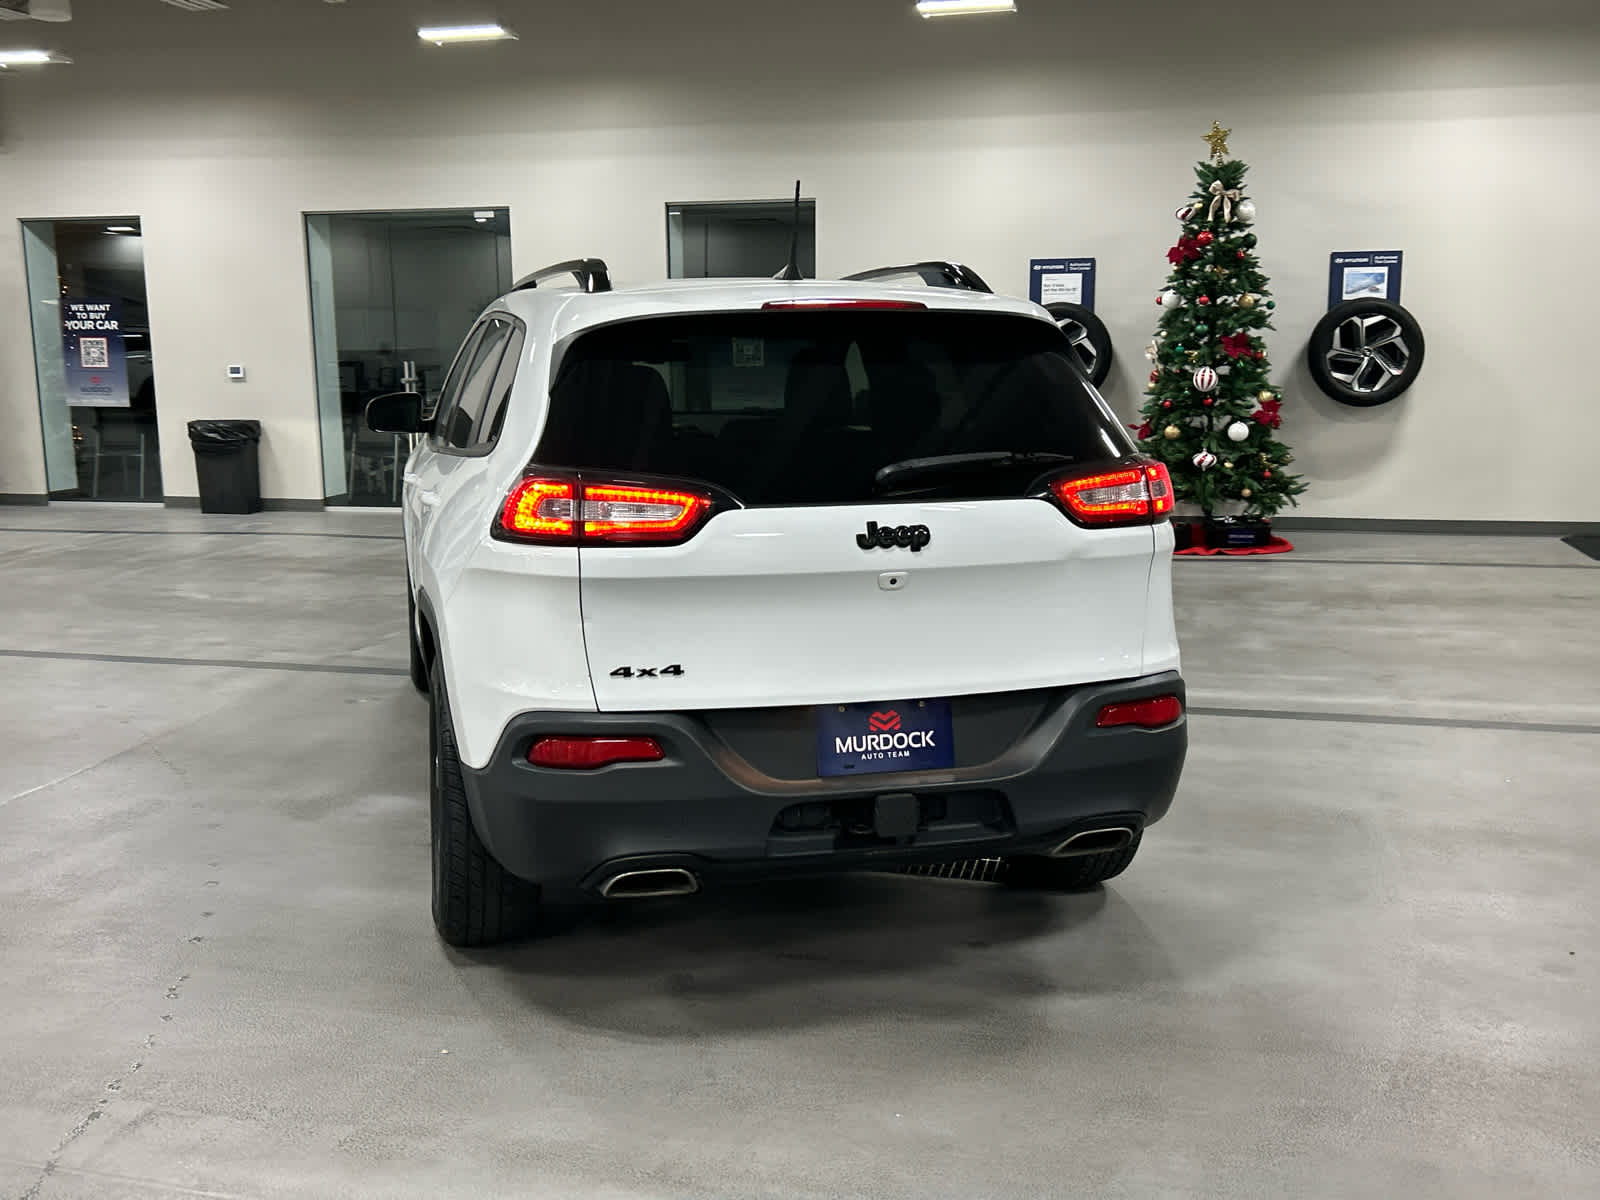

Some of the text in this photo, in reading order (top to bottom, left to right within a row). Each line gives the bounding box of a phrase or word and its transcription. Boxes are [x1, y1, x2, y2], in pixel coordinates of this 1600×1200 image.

[65, 320, 119, 330] YOUR CAR
[856, 521, 931, 552] Jeep
[609, 664, 685, 678] 4x4
[835, 730, 936, 753] MURDOCK
[861, 750, 910, 760] AUTO TEAM
